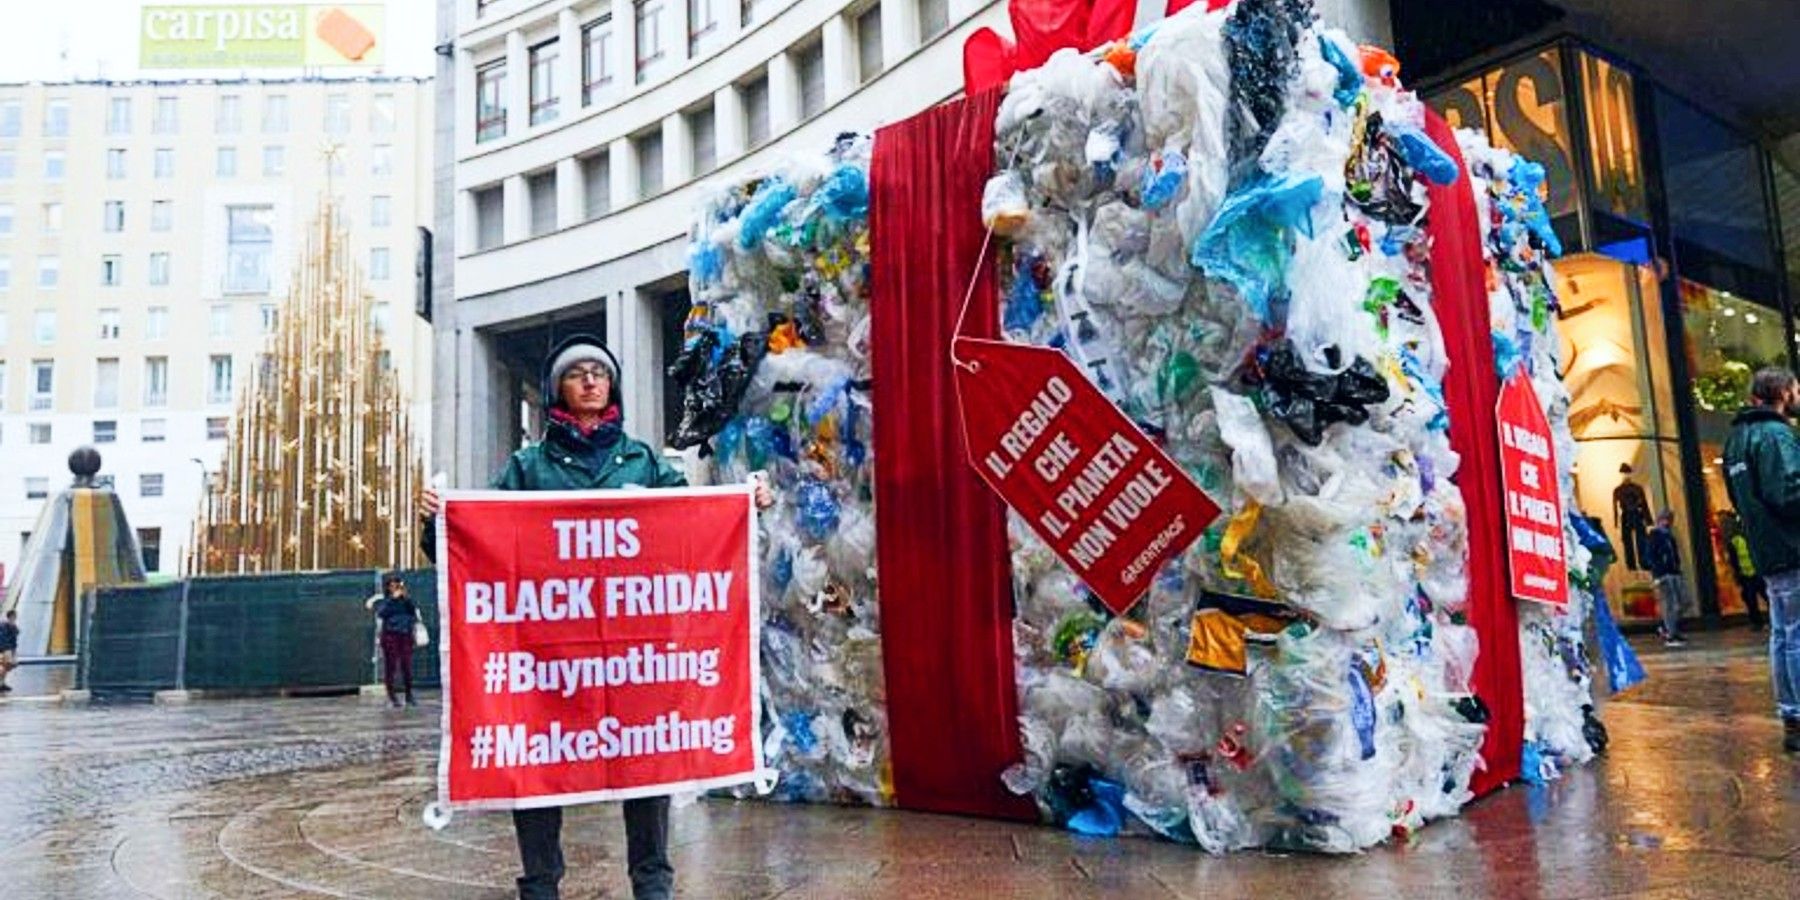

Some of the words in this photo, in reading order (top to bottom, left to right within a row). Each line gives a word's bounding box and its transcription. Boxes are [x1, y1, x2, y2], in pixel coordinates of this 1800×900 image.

[146, 8, 300, 50] carpisa
[985, 450, 1013, 480] IL
[1000, 376, 1073, 461] REGALO
[1033, 431, 1081, 483] CHE
[1040, 510, 1071, 539] IL
[1056, 432, 1139, 521] PIANETA
[552, 518, 641, 560] THIS
[1068, 519, 1117, 571] NON
[1103, 458, 1173, 531] VUOLE
[465, 577, 596, 624] BLACK
[604, 570, 733, 618] FRIDAY
[484, 643, 721, 698] #Buynothing
[470, 711, 737, 769] #MakeSmthng
